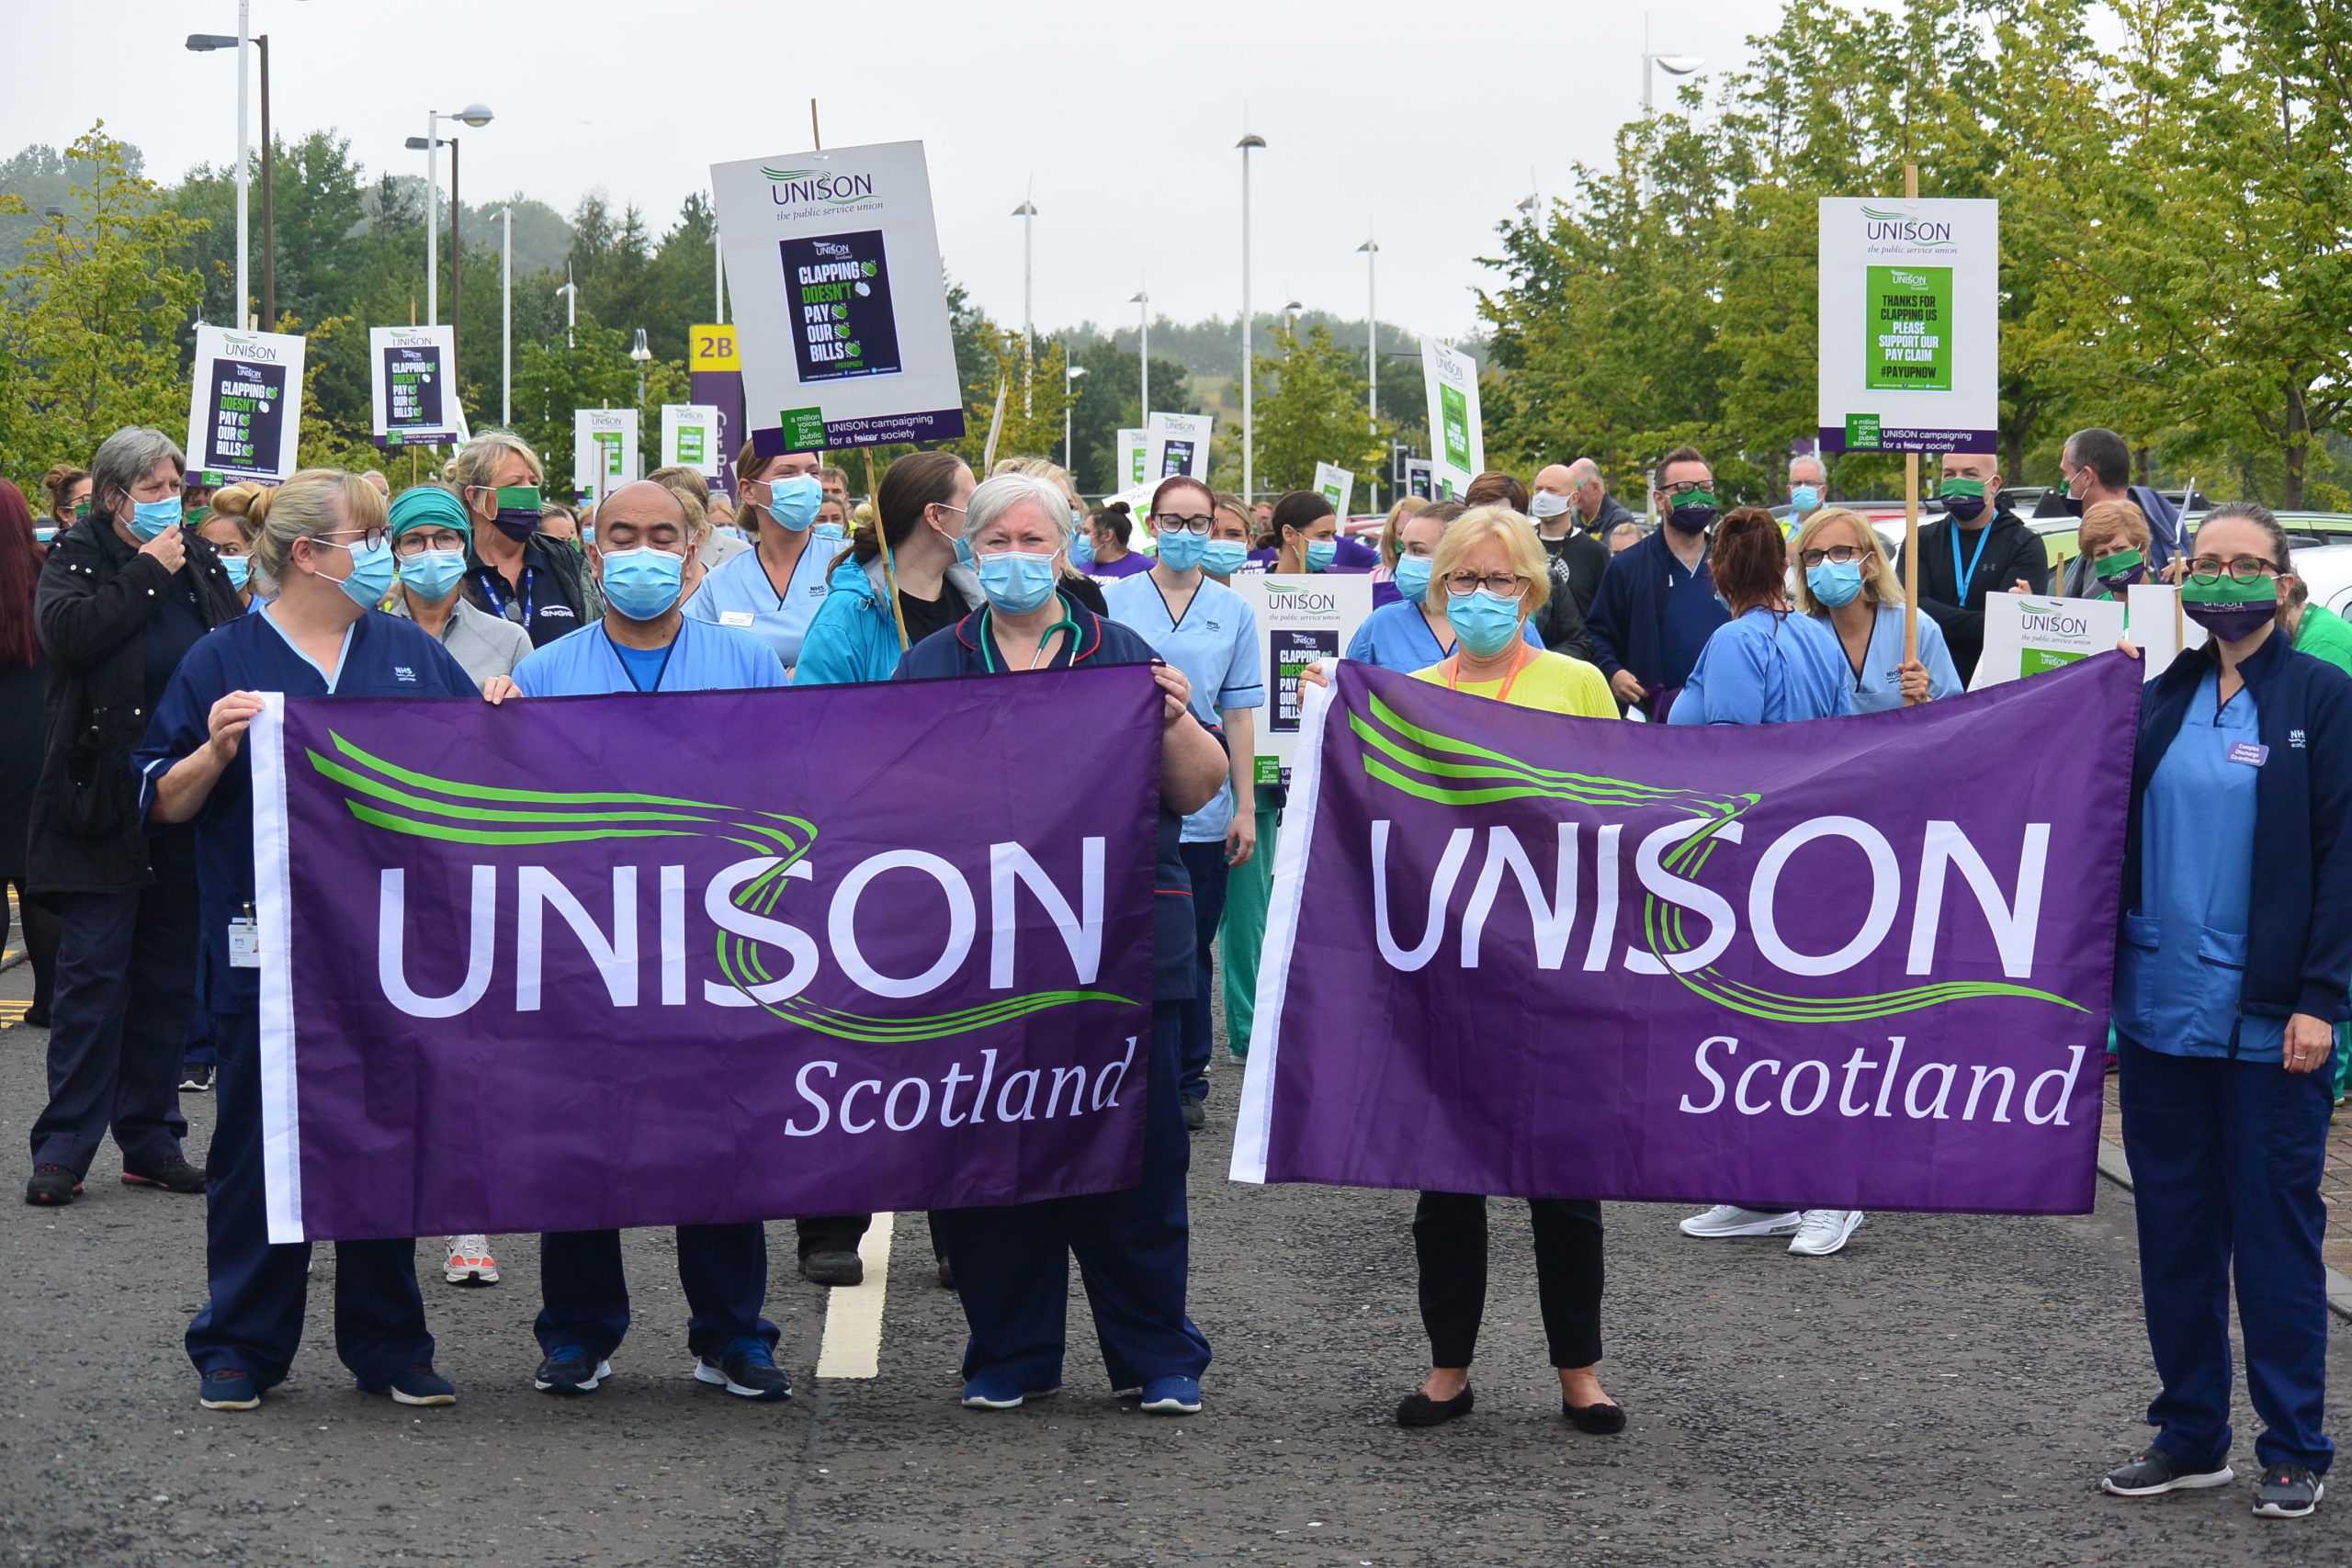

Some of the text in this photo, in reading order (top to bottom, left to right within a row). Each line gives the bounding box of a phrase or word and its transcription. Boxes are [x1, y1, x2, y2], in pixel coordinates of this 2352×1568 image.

[772, 174, 873, 206] UNISON
[776, 201, 884, 220] the public service union
[1867, 221, 1951, 241] UNISON
[816, 244, 849, 256] UNISON
[1868, 244, 1958, 255] the public service union
[798, 261, 860, 285] CLAPPING
[1892, 275, 1926, 284] UNISON
[801, 282, 852, 304] DOESN'T
[1883, 295, 1936, 308] THANKS FOR
[804, 304, 830, 324] PAY
[1881, 308, 1938, 321] CLAPPING US
[807, 323, 833, 343] OUR
[1893, 321, 1926, 334] PLEASE
[392, 337, 432, 346] UNISON
[700, 337, 733, 358] 2B
[1879, 334, 1939, 348] SUPPORT OUR
[226, 343, 277, 360] UNISON
[809, 342, 844, 362] BILLS
[1885, 348, 1932, 361] PAY CLAIM
[392, 362, 426, 374] CLAPPING
[1436, 356, 1464, 379] UNISON
[1881, 366, 1936, 378] #PAYUPNOW
[392, 374, 421, 384] DOESN'T
[221, 380, 266, 400] CLAPPING
[393, 385, 408, 395] PAY
[220, 396, 257, 412] DOESN'T
[393, 396, 408, 406] OUR
[219, 411, 239, 426] PAY
[393, 407, 413, 418] BILLS
[676, 412, 704, 420] UNISON
[797, 413, 820, 423] million
[592, 416, 622, 426] UNISON
[797, 420, 820, 428] voices
[827, 414, 933, 434] UNISON campaigning
[1165, 422, 1196, 432] UNISON
[217, 426, 236, 441] OUR
[799, 432, 821, 441] public
[830, 435, 842, 446] for
[881, 429, 915, 441] society
[1883, 430, 1972, 441] UNISON campaigning
[216, 440, 242, 457] BILLS
[795, 438, 824, 447] services
[1883, 441, 1894, 449] for
[1926, 442, 1955, 451] society
[1269, 593, 1335, 610] UNISON
[1280, 614, 1298, 622] public
[2021, 615, 2087, 634] UNISON
[2031, 635, 2050, 643] public
[1280, 649, 1320, 663] CLAPPING
[394, 666, 413, 674] NHS
[1280, 678, 1298, 691] PAY
[1280, 693, 1296, 705] OUR
[2235, 749, 2259, 758] Discharge
[2238, 743, 2260, 751] Complex
[1372, 816, 2052, 979] UNISON
[379, 836, 1105, 1019] UNISON
[785, 1037, 1137, 1137] Scotland
[1679, 1035, 2086, 1126] Scotland
